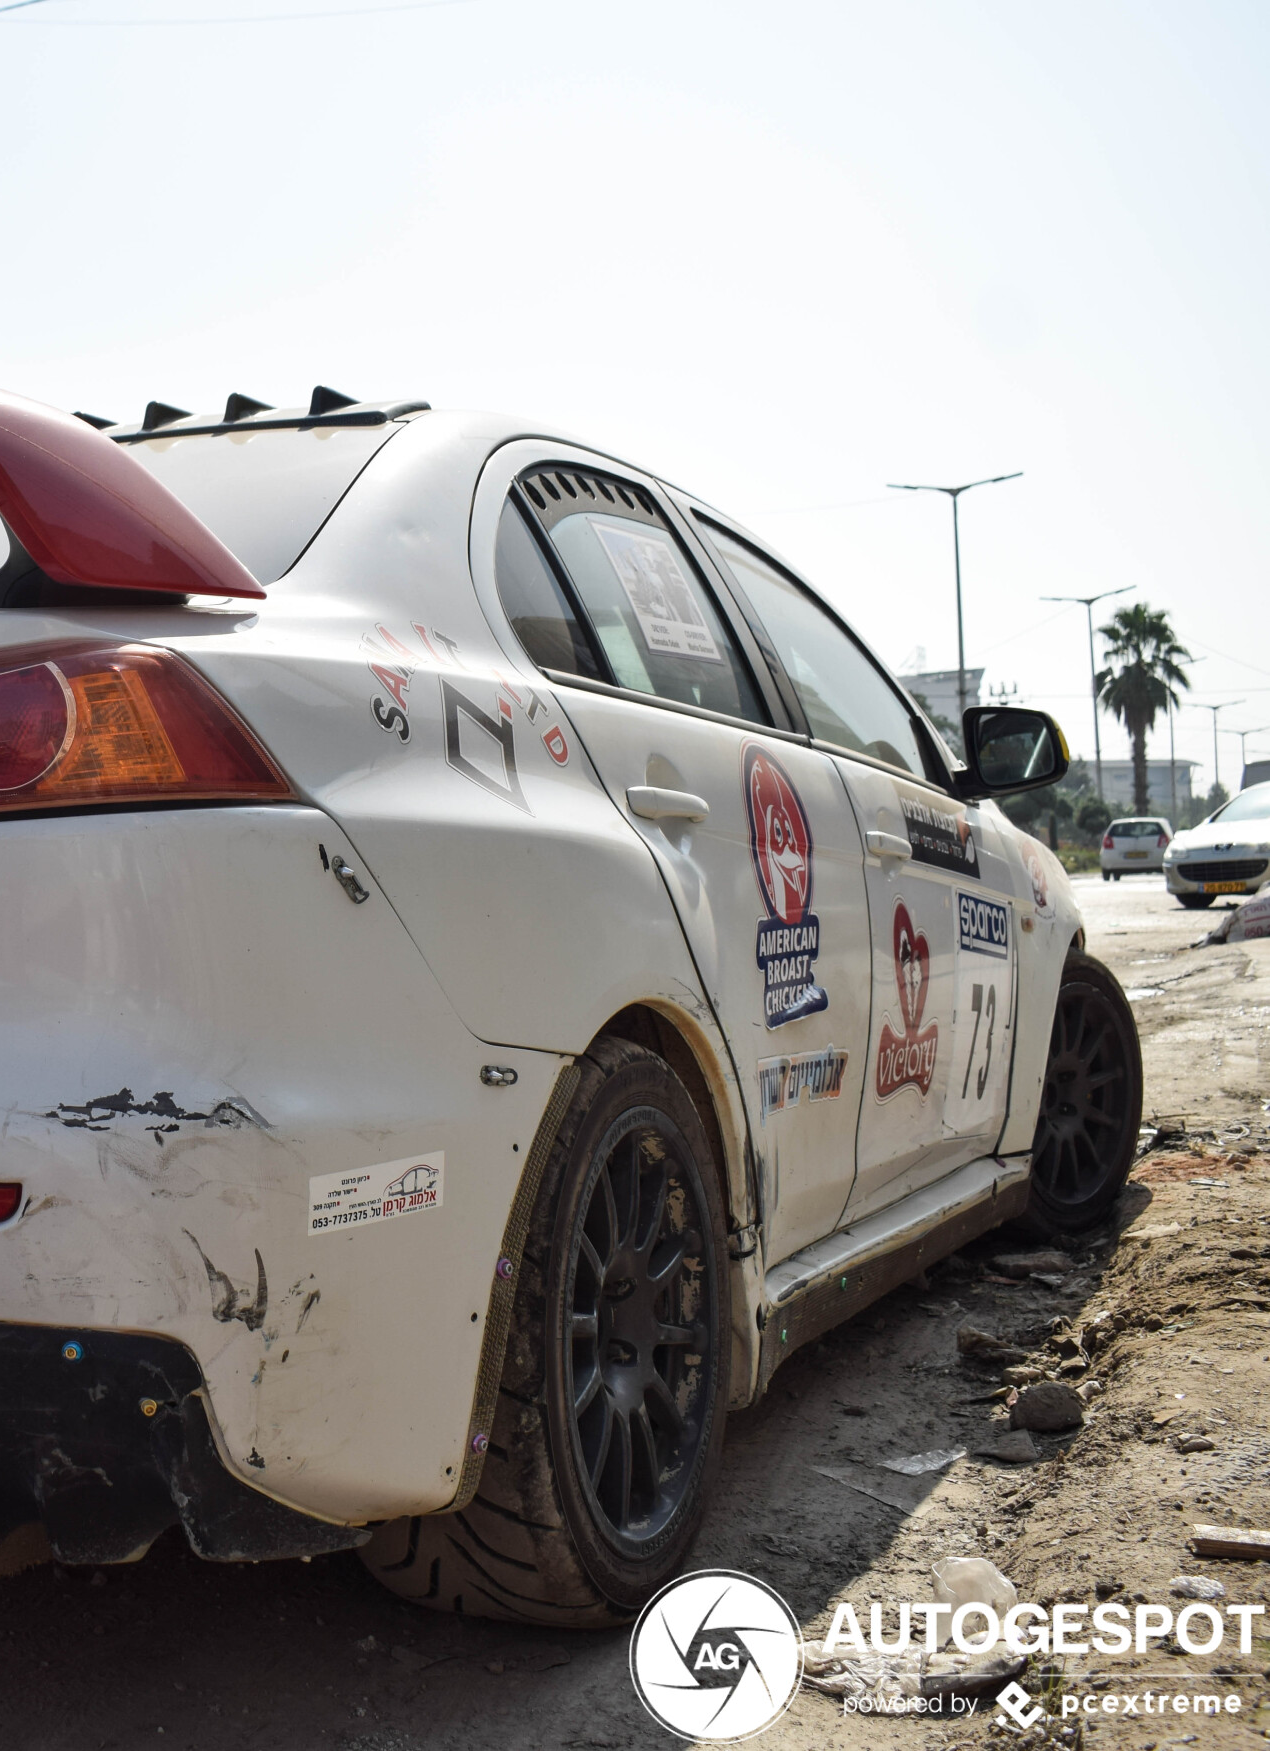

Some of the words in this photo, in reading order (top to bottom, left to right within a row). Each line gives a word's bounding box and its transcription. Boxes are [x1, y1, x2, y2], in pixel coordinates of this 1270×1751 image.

[960, 897, 1007, 949] sparco
[759, 926, 817, 957] AMERICAN
[767, 955, 809, 985] BROAST
[766, 983, 822, 1016] CHICKEN
[961, 983, 997, 1100] 73
[383, 1197, 406, 1217] קרמן
[408, 1189, 437, 1207] אלמוג
[312, 1209, 368, 1229] 053-7737375
